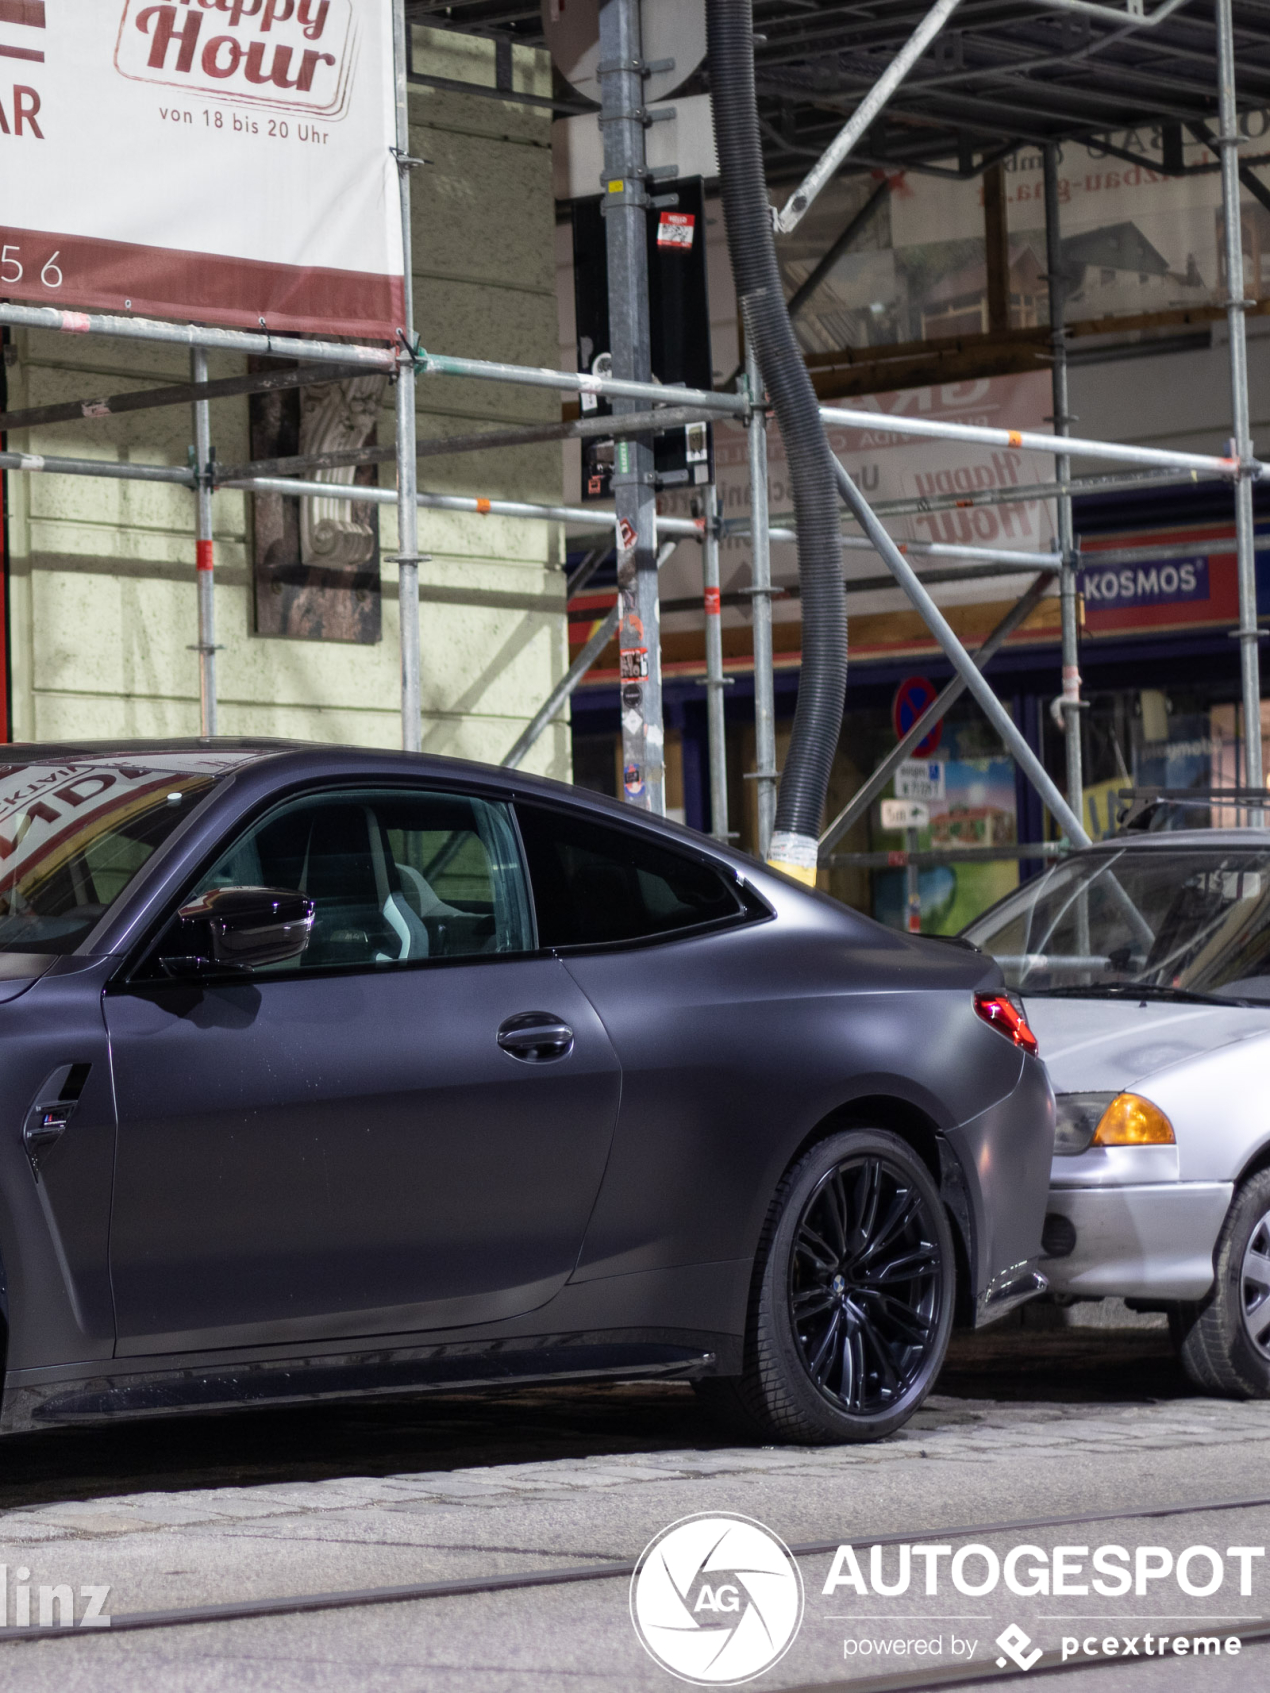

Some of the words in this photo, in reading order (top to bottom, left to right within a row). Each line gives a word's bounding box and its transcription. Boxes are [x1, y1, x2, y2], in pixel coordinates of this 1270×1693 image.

[135, 5, 336, 92] Hour
[159, 107, 192, 124] von
[202, 109, 223, 129] 18
[232, 113, 259, 134] bis
[267, 119, 289, 138] 20
[298, 124, 329, 144] Uhr
[0, 245, 63, 287] 56
